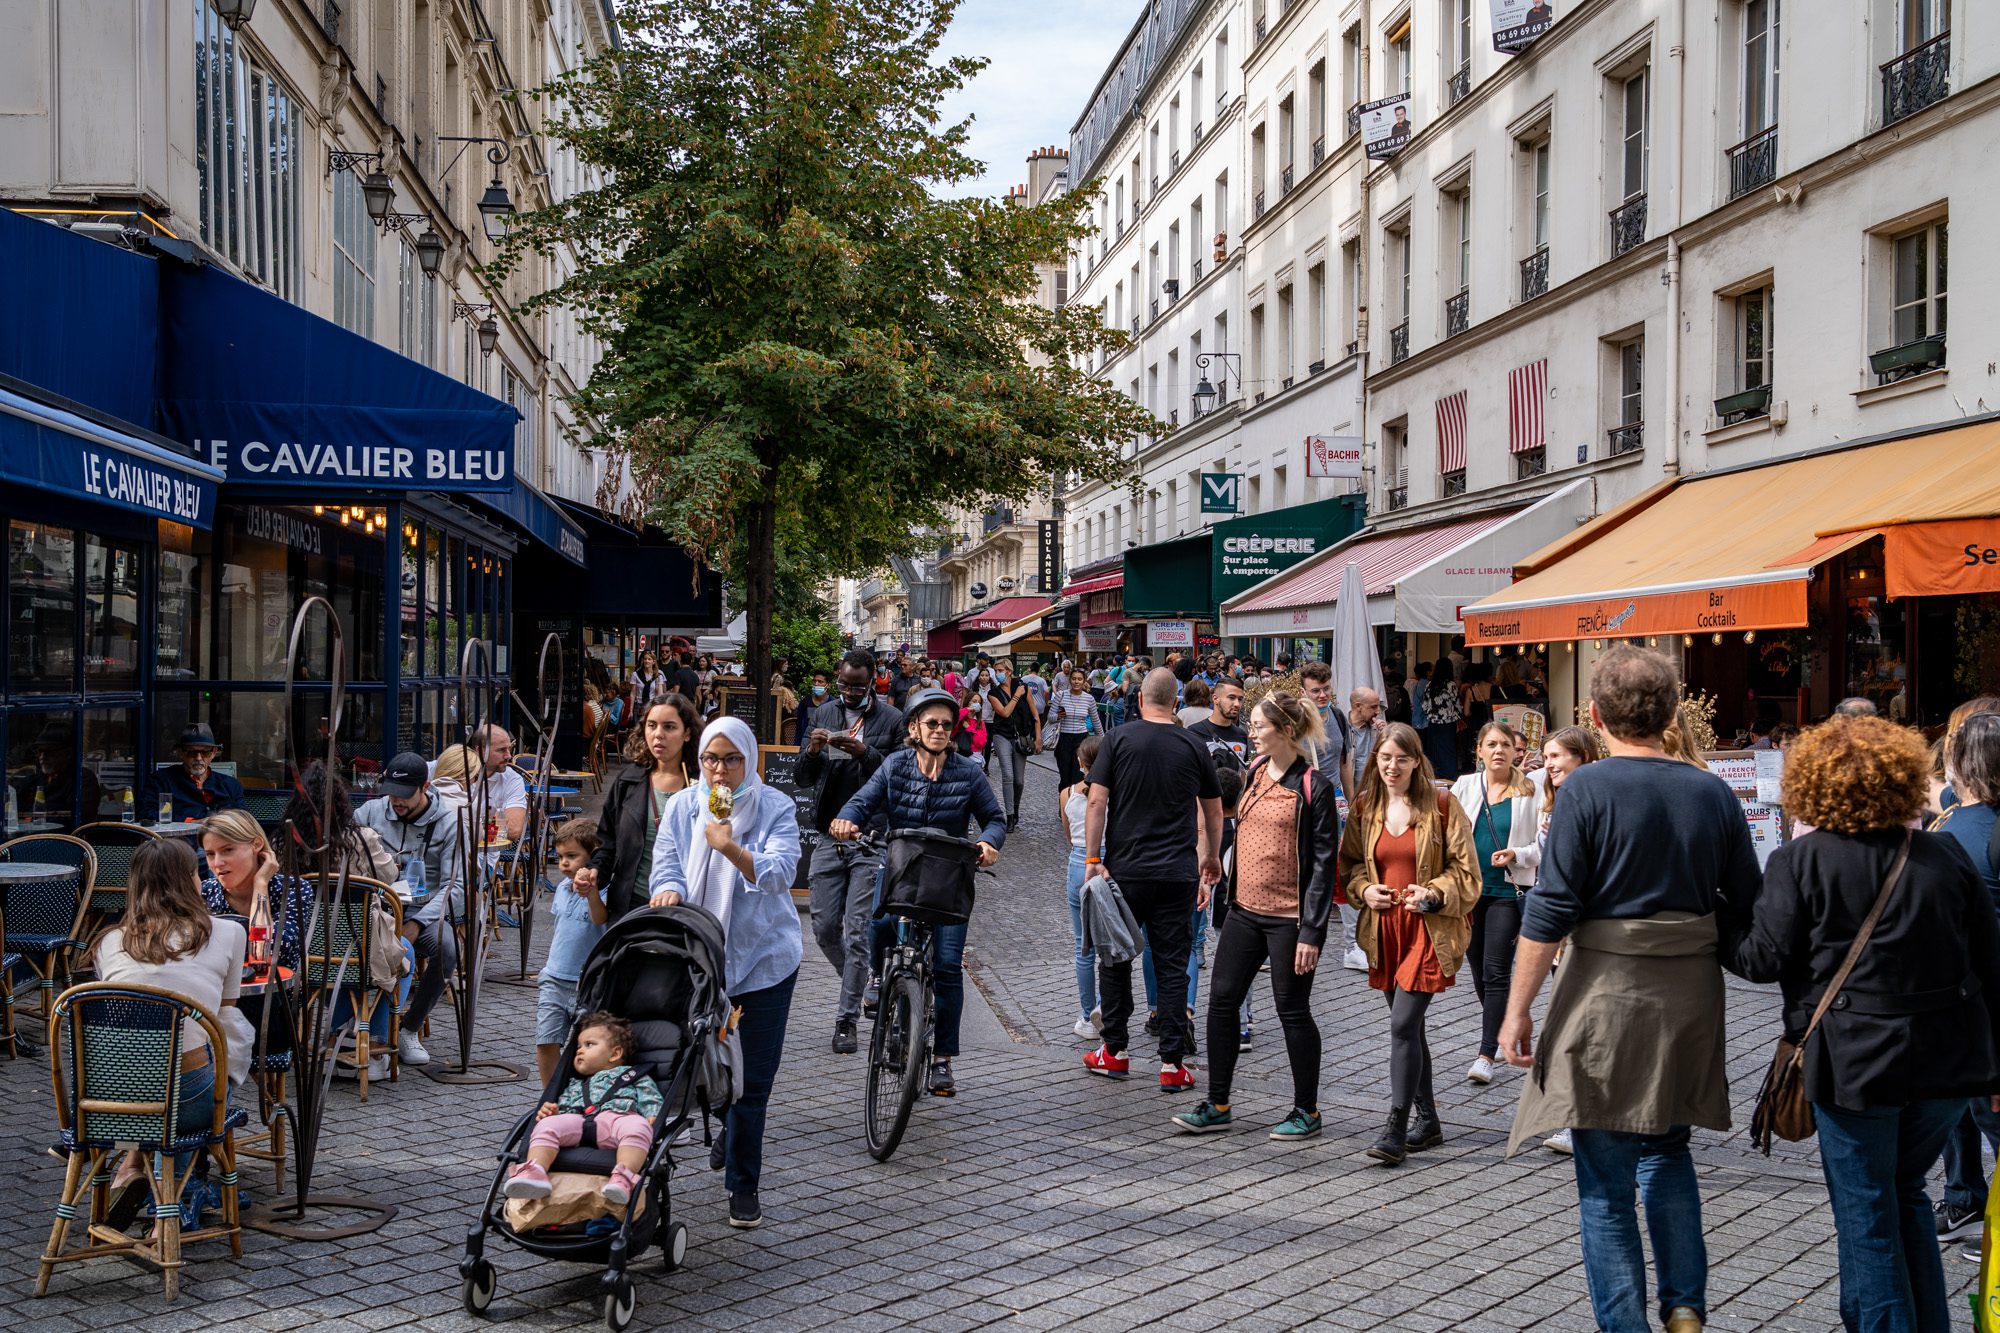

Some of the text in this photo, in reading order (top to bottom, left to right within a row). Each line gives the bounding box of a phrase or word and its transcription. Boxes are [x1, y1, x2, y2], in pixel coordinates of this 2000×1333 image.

[1497, 32, 1507, 42] 06
[1508, 29, 1518, 39] 69
[1520, 26, 1530, 36] 69
[1532, 23, 1542, 33] 69
[1365, 102, 1380, 110] BIEN
[1380, 94, 1402, 105] VENDU
[1378, 141, 1385, 149] 69
[1396, 136, 1404, 144] 69
[240, 441, 415, 479] CAVALIER
[426, 448, 506, 481] BLEU
[1328, 450, 1360, 460] BACHIR
[82, 450, 201, 520] LE CAVALIER BLEU
[1223, 533, 1315, 553] CRÊPERIE
[1222, 556, 1269, 565] Sur place
[1222, 565, 1280, 576] À emporter
[1478, 567, 1512, 575] LIBANA
[1709, 592, 1724, 607] Bar
[980, 621, 996, 629] HALL
[1577, 613, 1607, 635] FRENCH
[1697, 610, 1737, 628] Cocktails
[1156, 631, 1186, 641] PIZZAS
[1479, 620, 1521, 637] Restaurant
